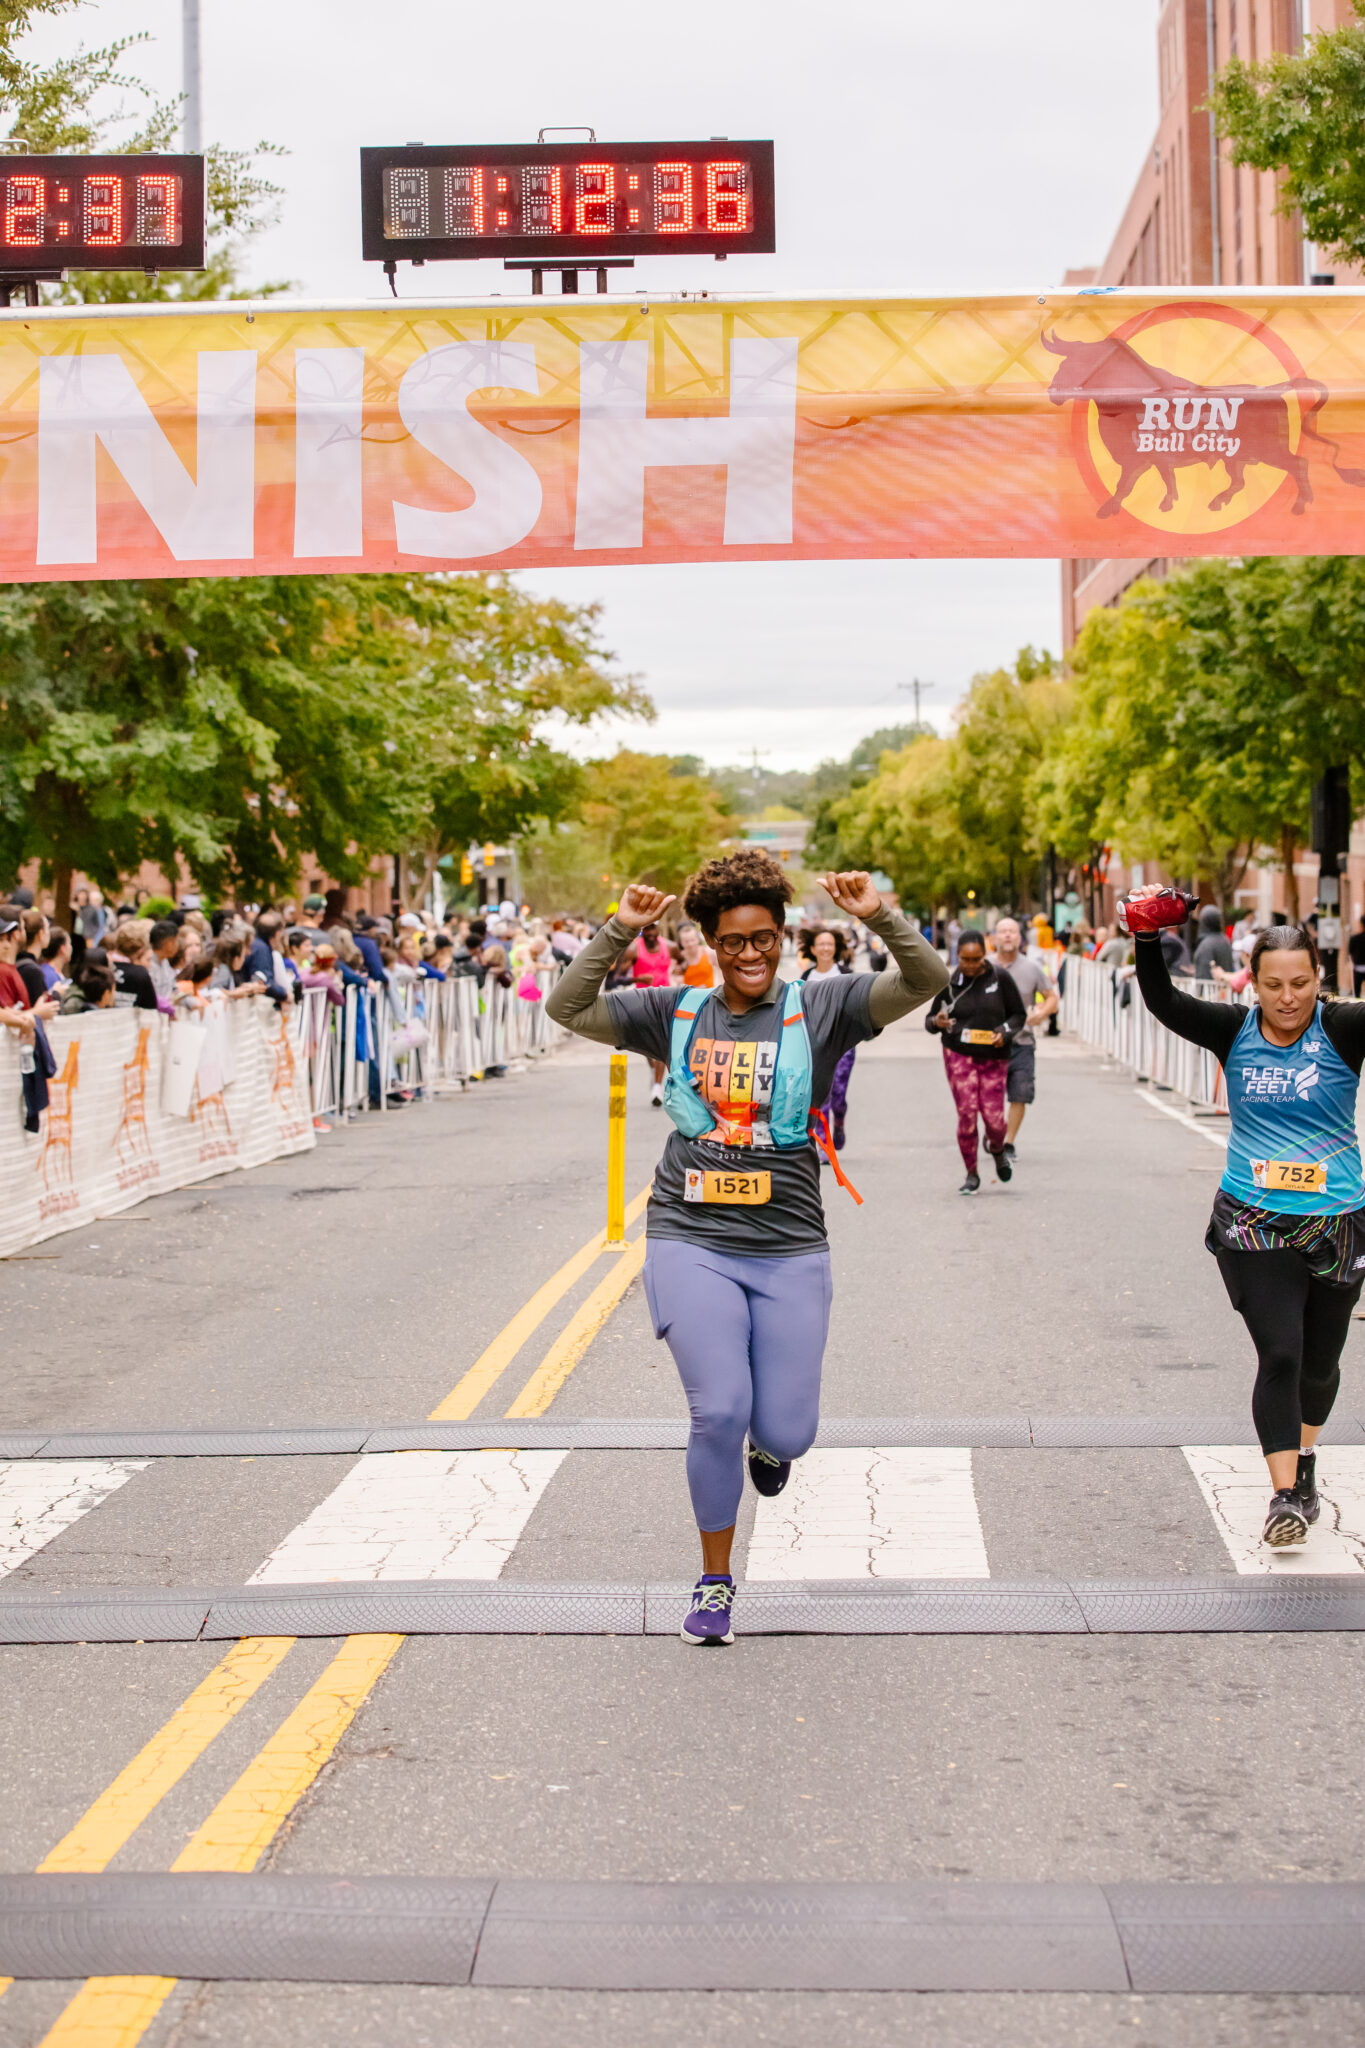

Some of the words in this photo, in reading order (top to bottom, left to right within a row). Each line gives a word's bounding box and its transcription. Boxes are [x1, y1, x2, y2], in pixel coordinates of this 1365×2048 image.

[473, 161, 747, 233] 1:12:36
[1137, 397, 1244, 430] RUN
[1137, 433, 1185, 452] Bull
[1192, 432, 1241, 457] City
[692, 1049, 773, 1069] BULL
[1242, 1067, 1296, 1080] FLEET
[1245, 1081, 1291, 1094] FEET
[1240, 1095, 1269, 1103] RACING
[1271, 1095, 1296, 1103] TEAM
[718, 1152, 742, 1160] 2023
[1279, 1166, 1315, 1183] 752
[714, 1178, 758, 1194] 1521
